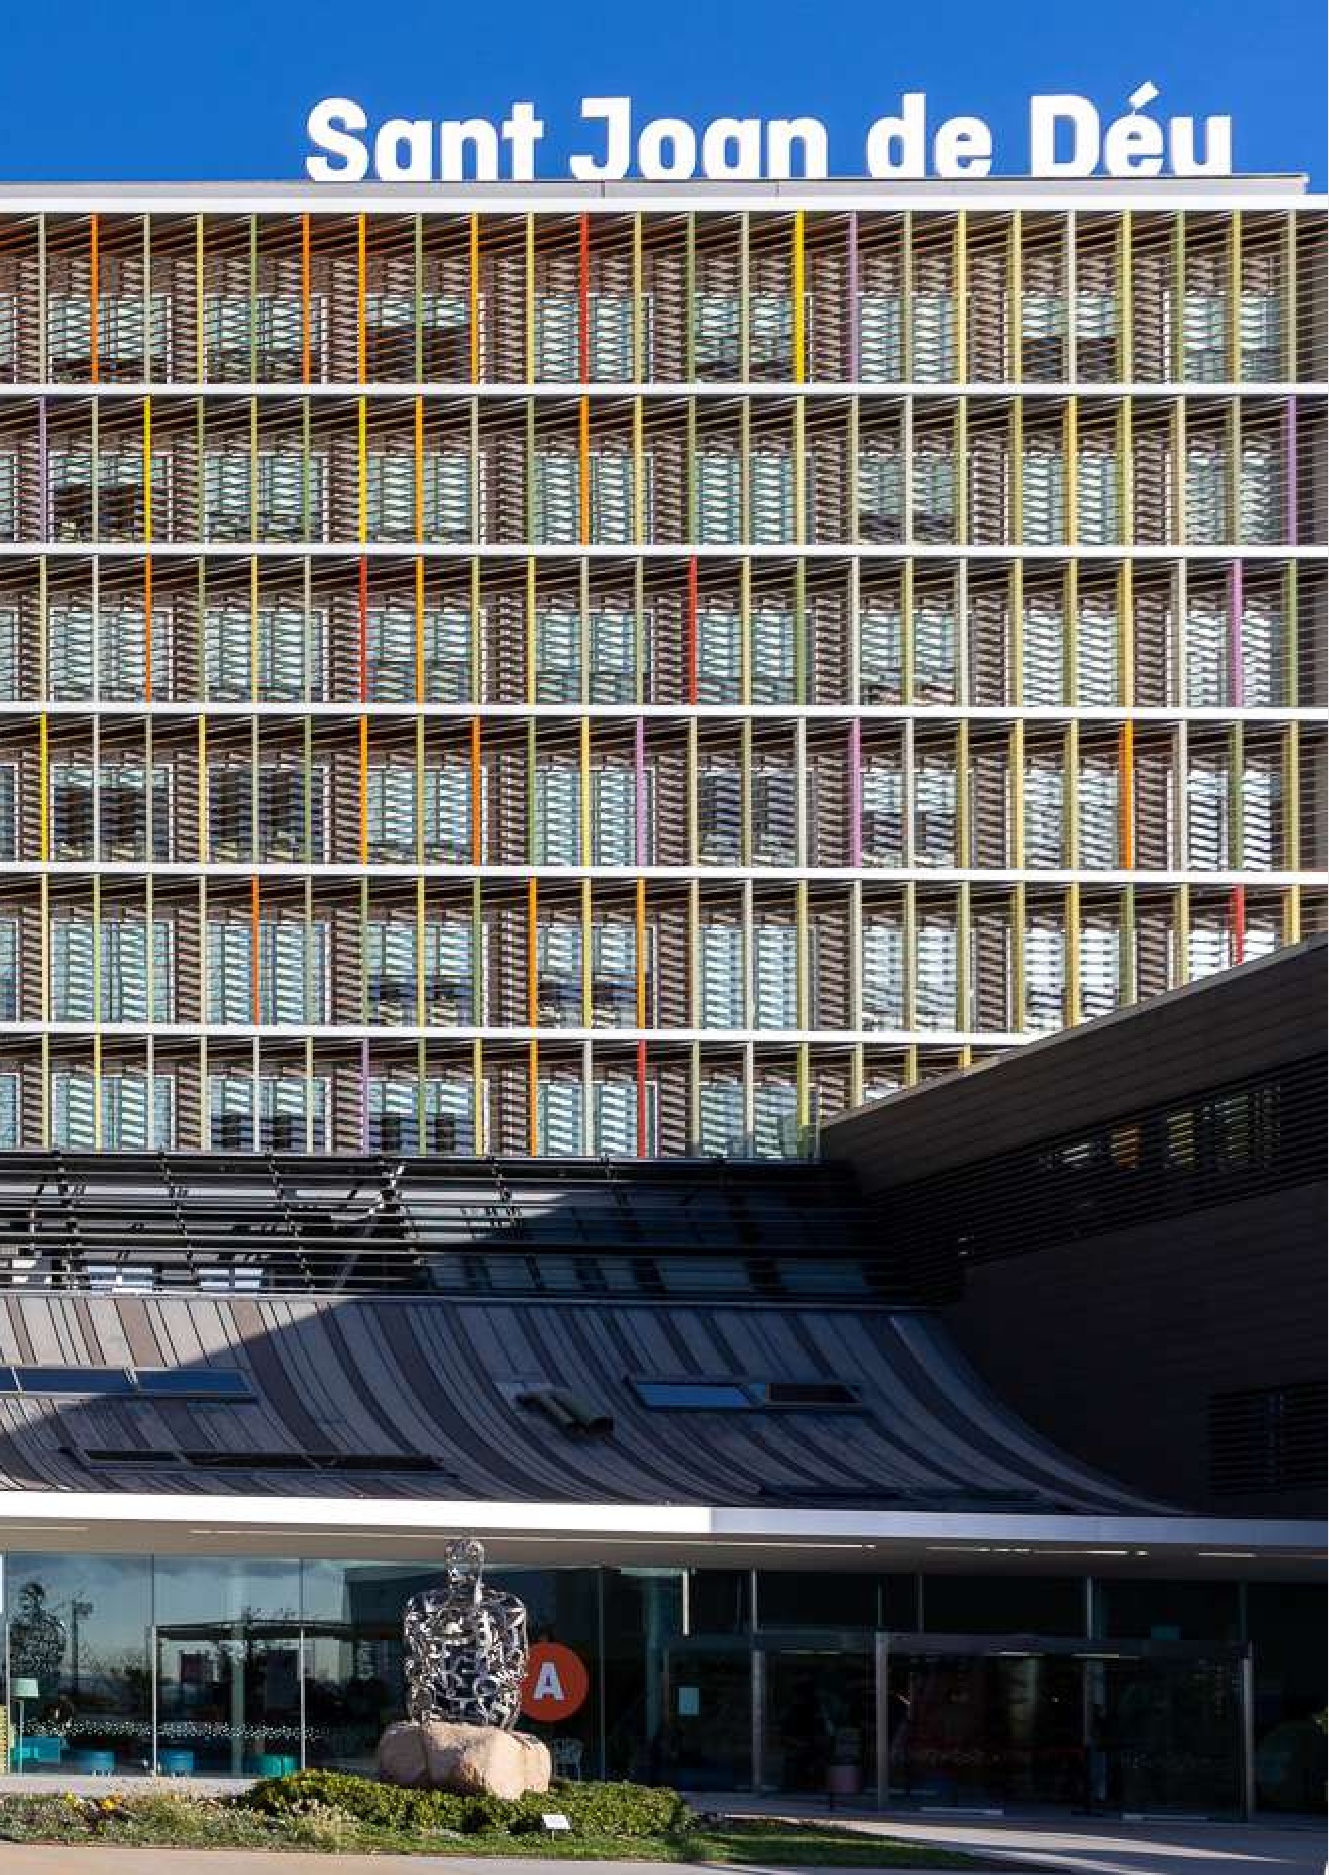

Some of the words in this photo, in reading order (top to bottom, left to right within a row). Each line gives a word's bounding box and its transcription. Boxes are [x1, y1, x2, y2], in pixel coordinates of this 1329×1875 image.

[306, 97, 543, 181] Sant
[569, 97, 828, 180] Joan
[867, 93, 993, 178] de
[1030, 81, 1233, 177] Déu
[533, 1662, 564, 1701] A
